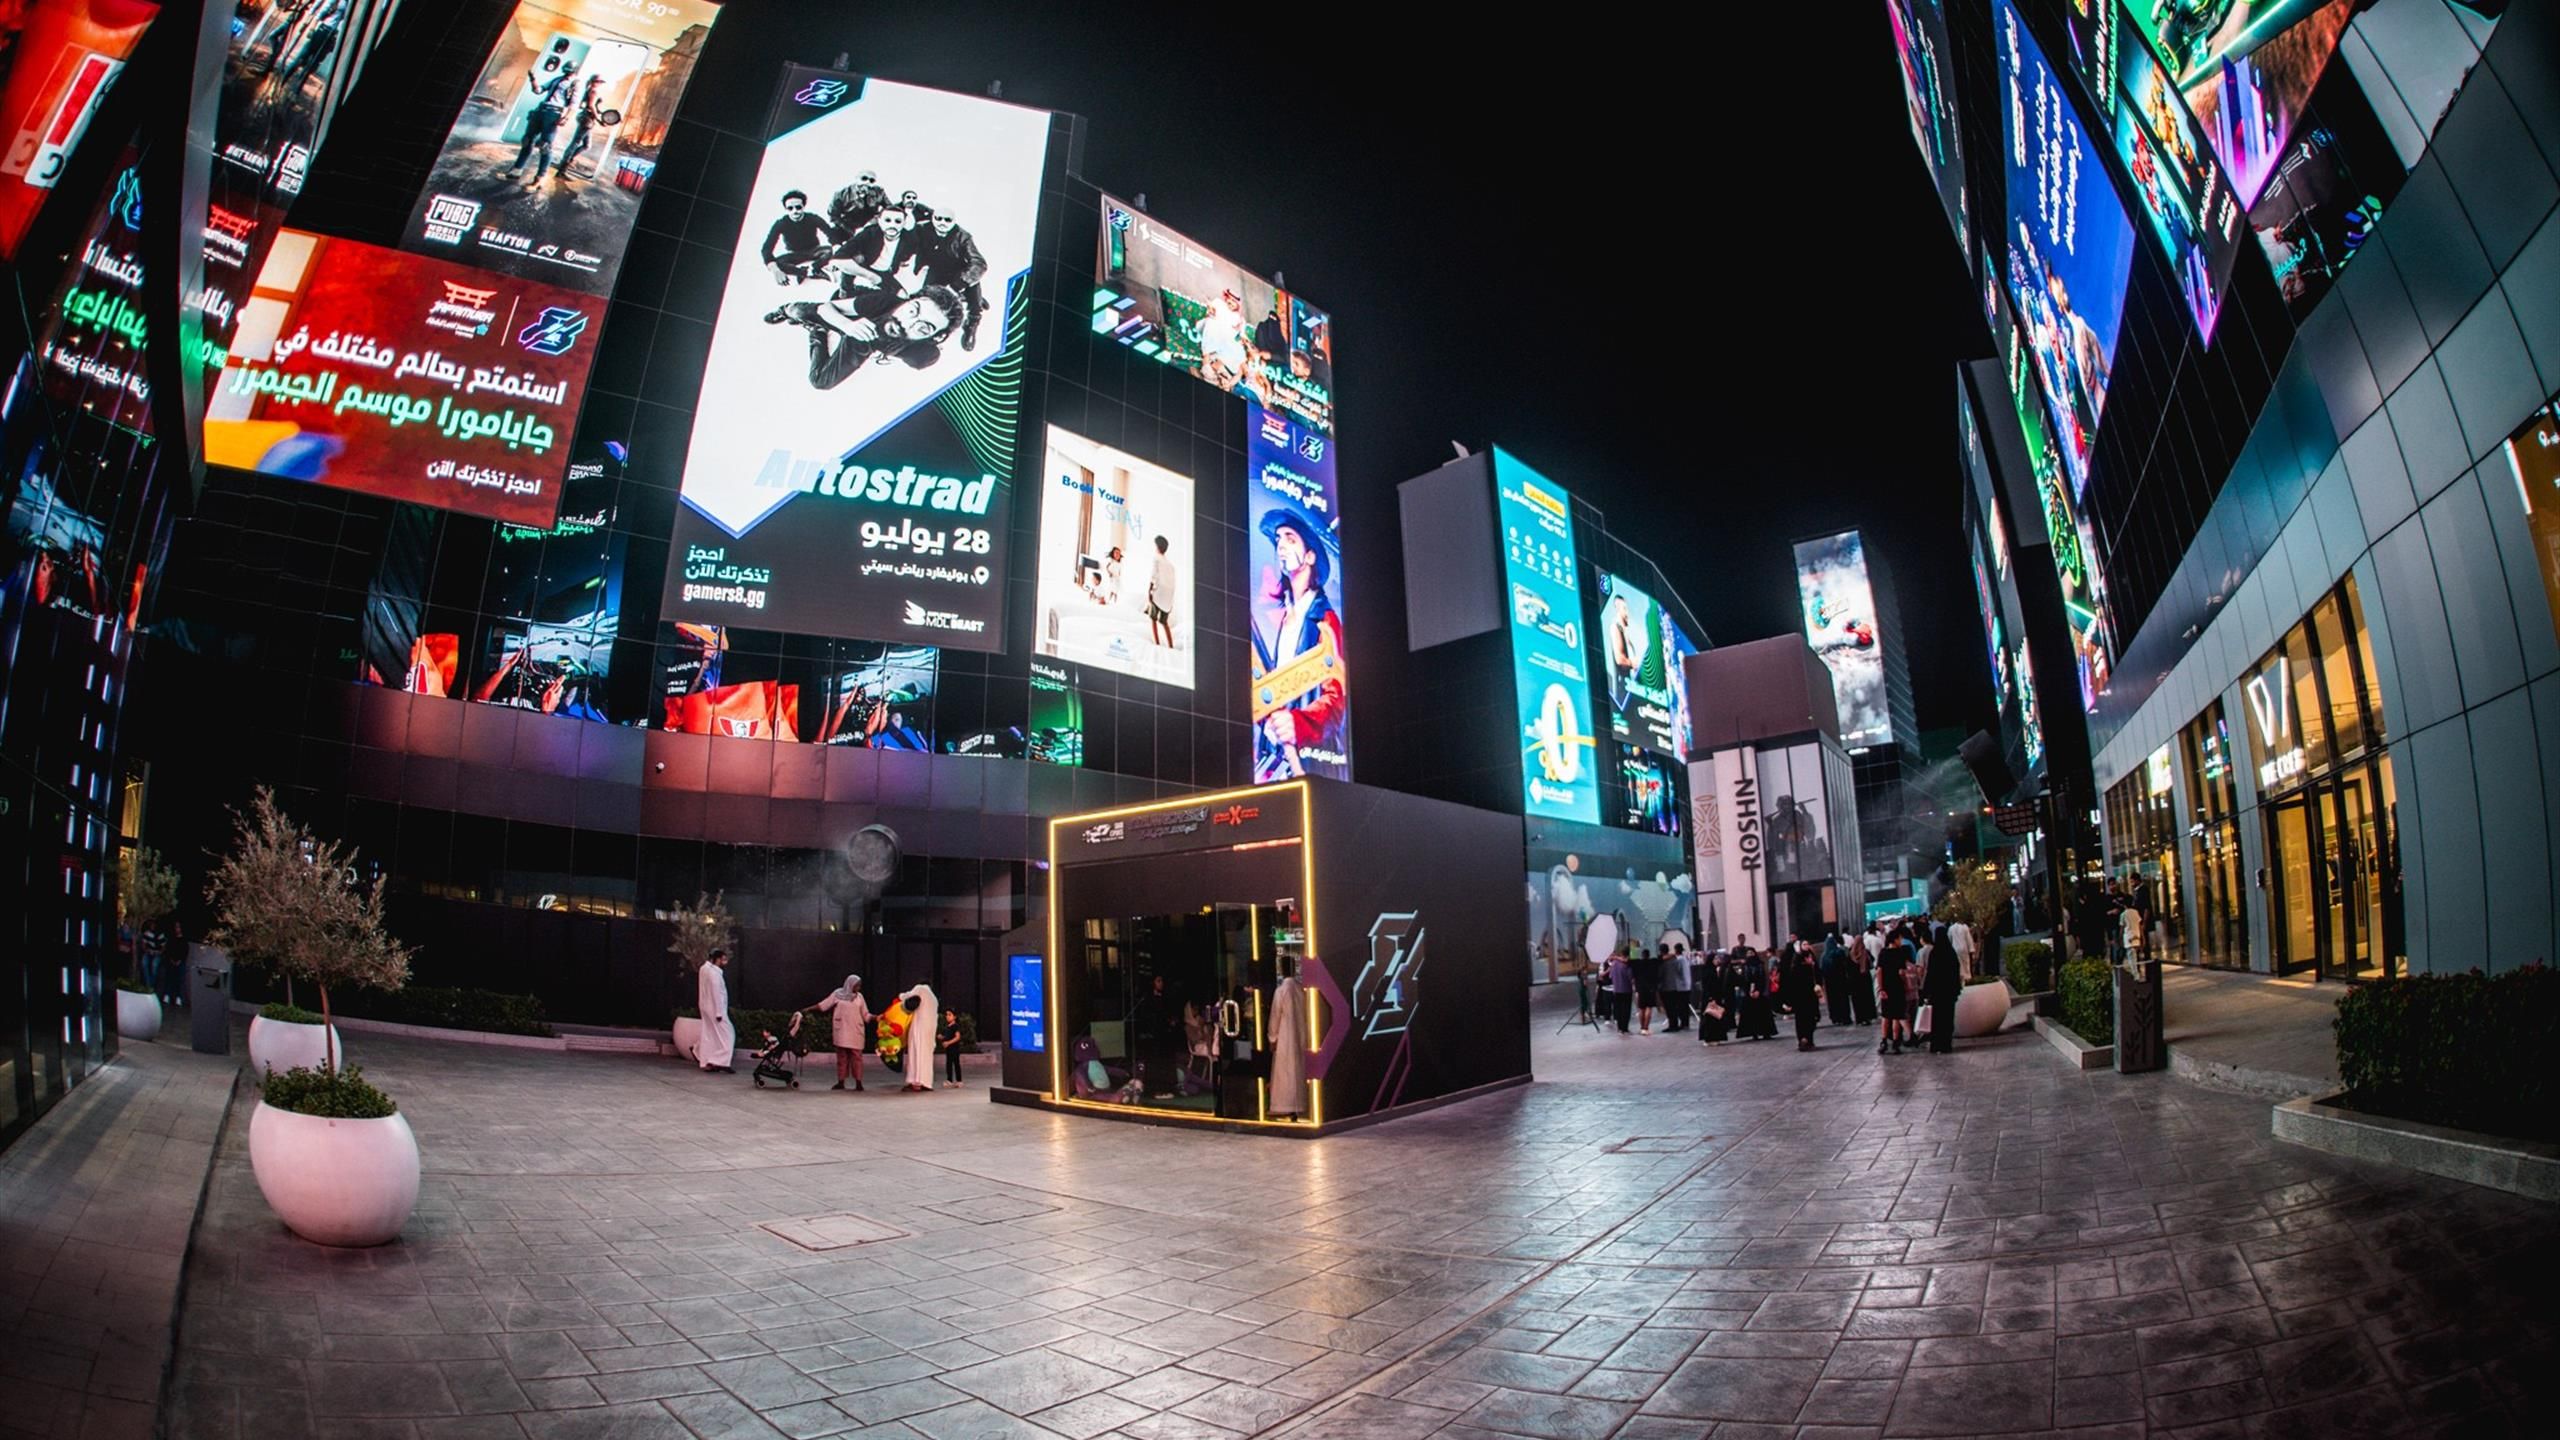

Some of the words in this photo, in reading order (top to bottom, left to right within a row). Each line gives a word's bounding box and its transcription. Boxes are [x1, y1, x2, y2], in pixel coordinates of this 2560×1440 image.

[432, 201, 473, 225] PUBG
[480, 229, 532, 250] KRAFTON
[272, 326, 310, 365] في
[310, 332, 395, 369] مختلف
[227, 356, 338, 407] الجيمرز
[394, 352, 466, 390] بعالم
[466, 365, 568, 406] استمتع
[334, 384, 433, 427] موسم
[437, 396, 556, 454] جابامورا
[426, 459, 456, 478] الآن
[455, 463, 506, 488] تذكرتك
[753, 448, 997, 515] Autostrad
[504, 473, 542, 496] احجز
[1061, 475, 1095, 496] Book
[1098, 487, 1125, 506] Your
[860, 517, 947, 556] يوليو
[952, 526, 992, 555] 28
[686, 544, 725, 562] احجز
[685, 563, 716, 580] الآن
[716, 567, 770, 584] تذكرتك
[860, 559, 894, 577] سيتي
[894, 563, 925, 579] رياض
[926, 566, 970, 584] بوليفارد
[682, 582, 767, 610] gamers8.gg
[1734, 777, 1763, 871] ROSHN
